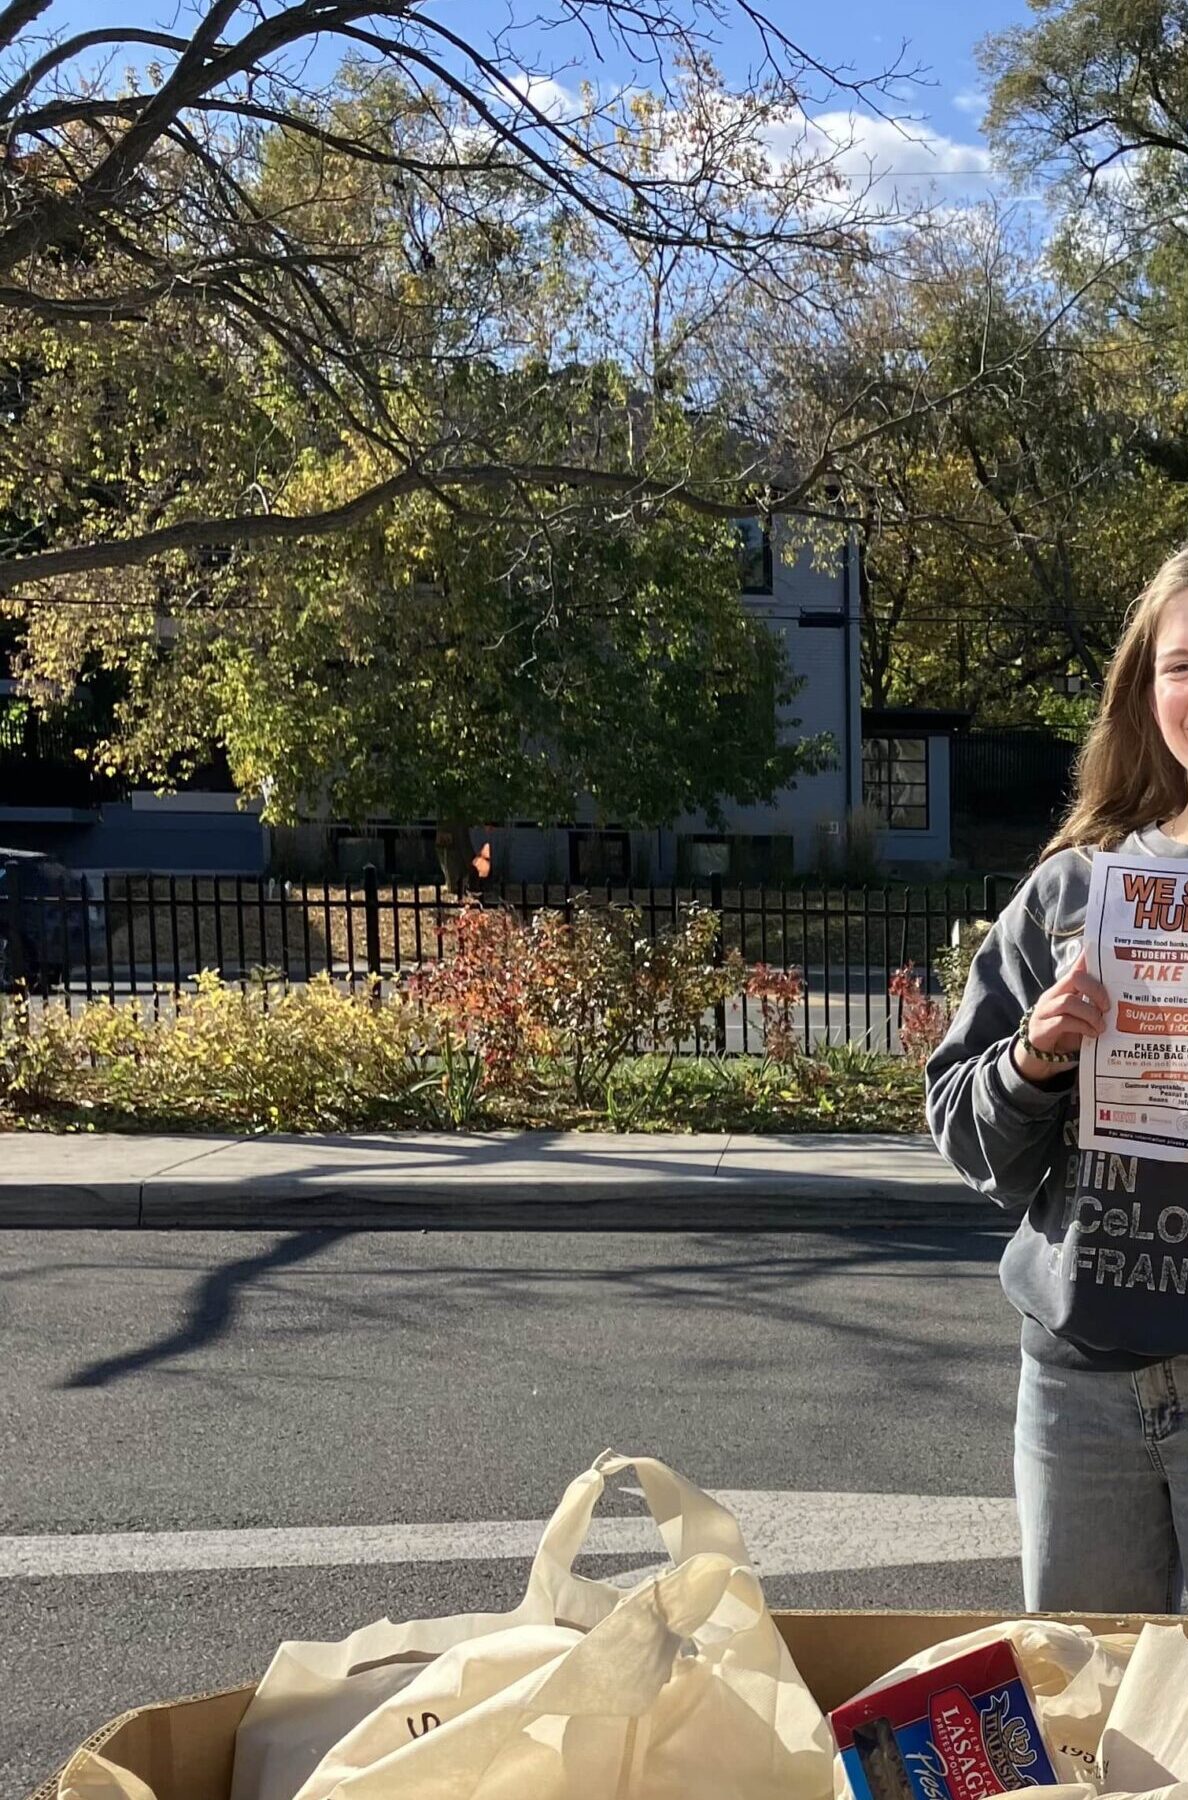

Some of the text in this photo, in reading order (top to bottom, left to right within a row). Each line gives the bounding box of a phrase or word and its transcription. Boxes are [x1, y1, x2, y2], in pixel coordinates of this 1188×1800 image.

[1123, 874, 1176, 905] WE
[1114, 936, 1131, 945] Every
[1131, 949, 1177, 960] STUDENTS
[1132, 964, 1185, 982] TAKE
[1123, 992, 1133, 1000] We
[1135, 994, 1149, 1002] will
[1152, 995, 1161, 1003] be
[1125, 1008, 1171, 1022] SUNDAY
[1139, 1022, 1166, 1032] from
[1134, 1043, 1171, 1053] PLEASE
[1111, 1050, 1160, 1060] ATTACHED
[1164, 1052, 1183, 1060] BAG
[984, 1711, 1022, 1790] ITALPASTA
